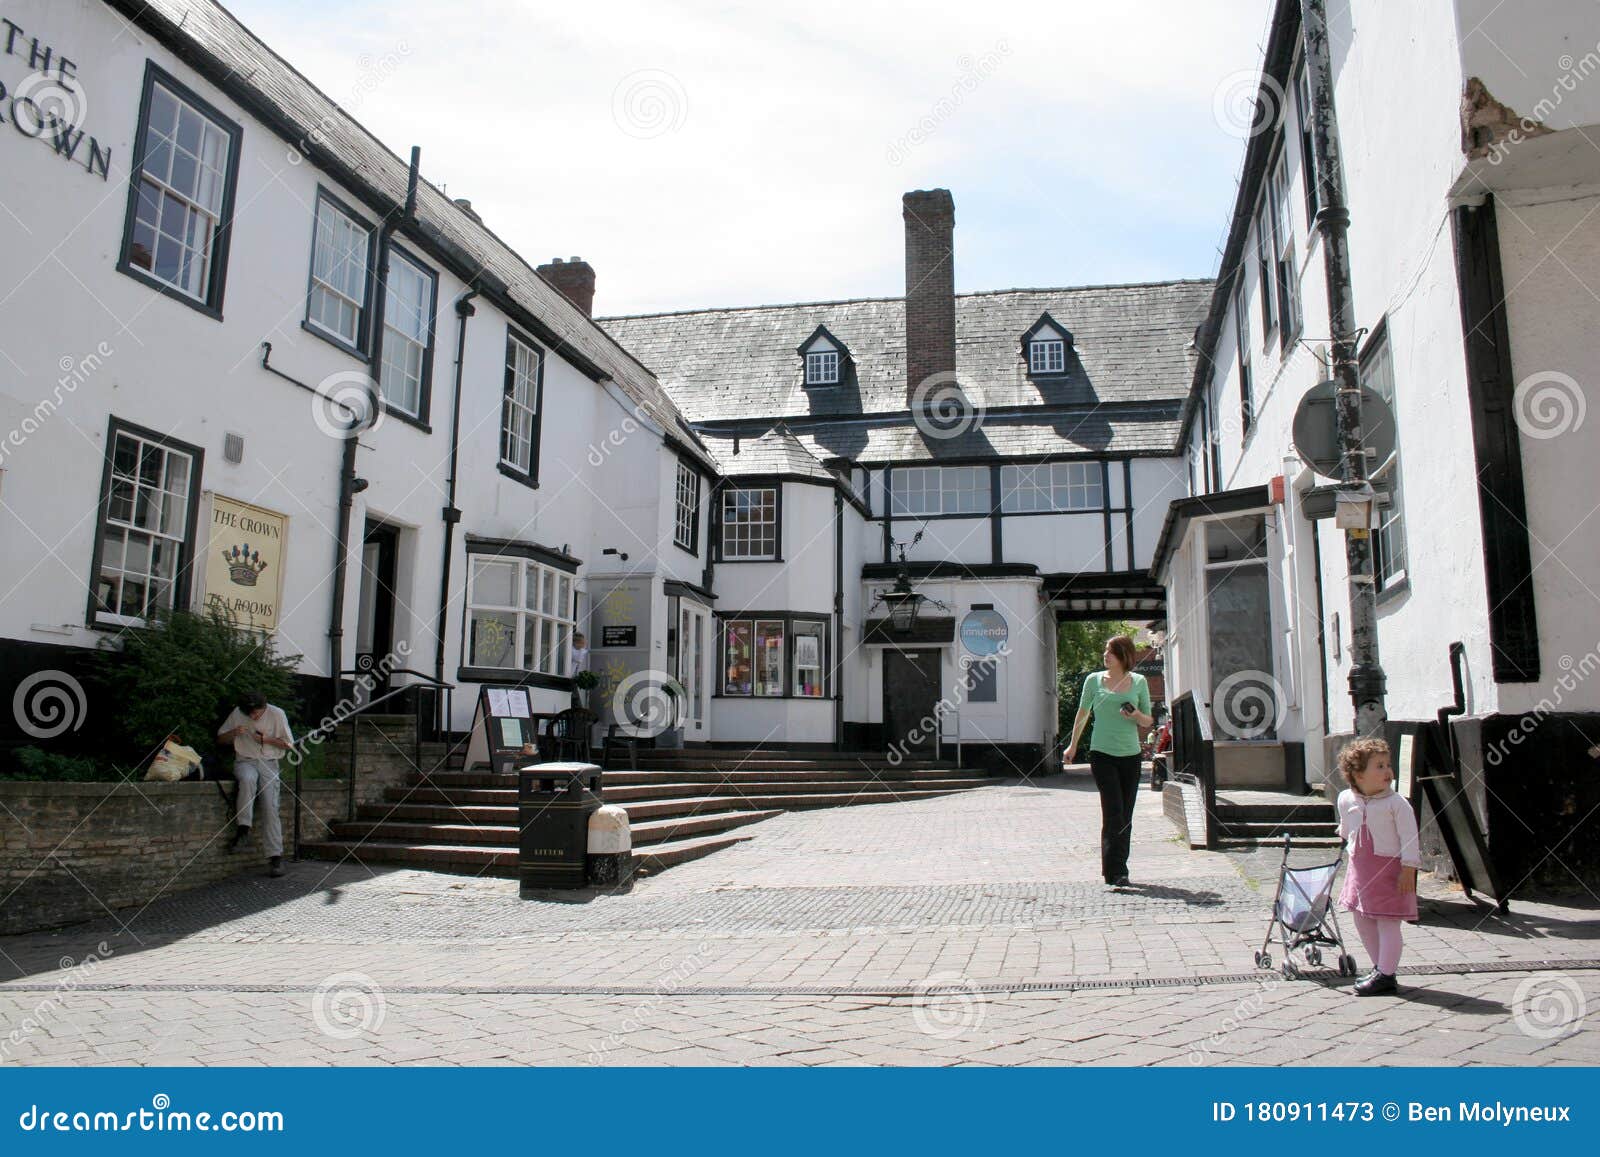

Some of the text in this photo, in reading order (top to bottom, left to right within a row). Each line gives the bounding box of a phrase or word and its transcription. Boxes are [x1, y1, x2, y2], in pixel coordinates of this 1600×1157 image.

[2, 17, 77, 94] THE
[0, 81, 112, 182] OWN
[213, 509, 280, 539] THE CROWN
[234, 598, 272, 617] ROOMS
[534, 848, 564, 856] LITTER
